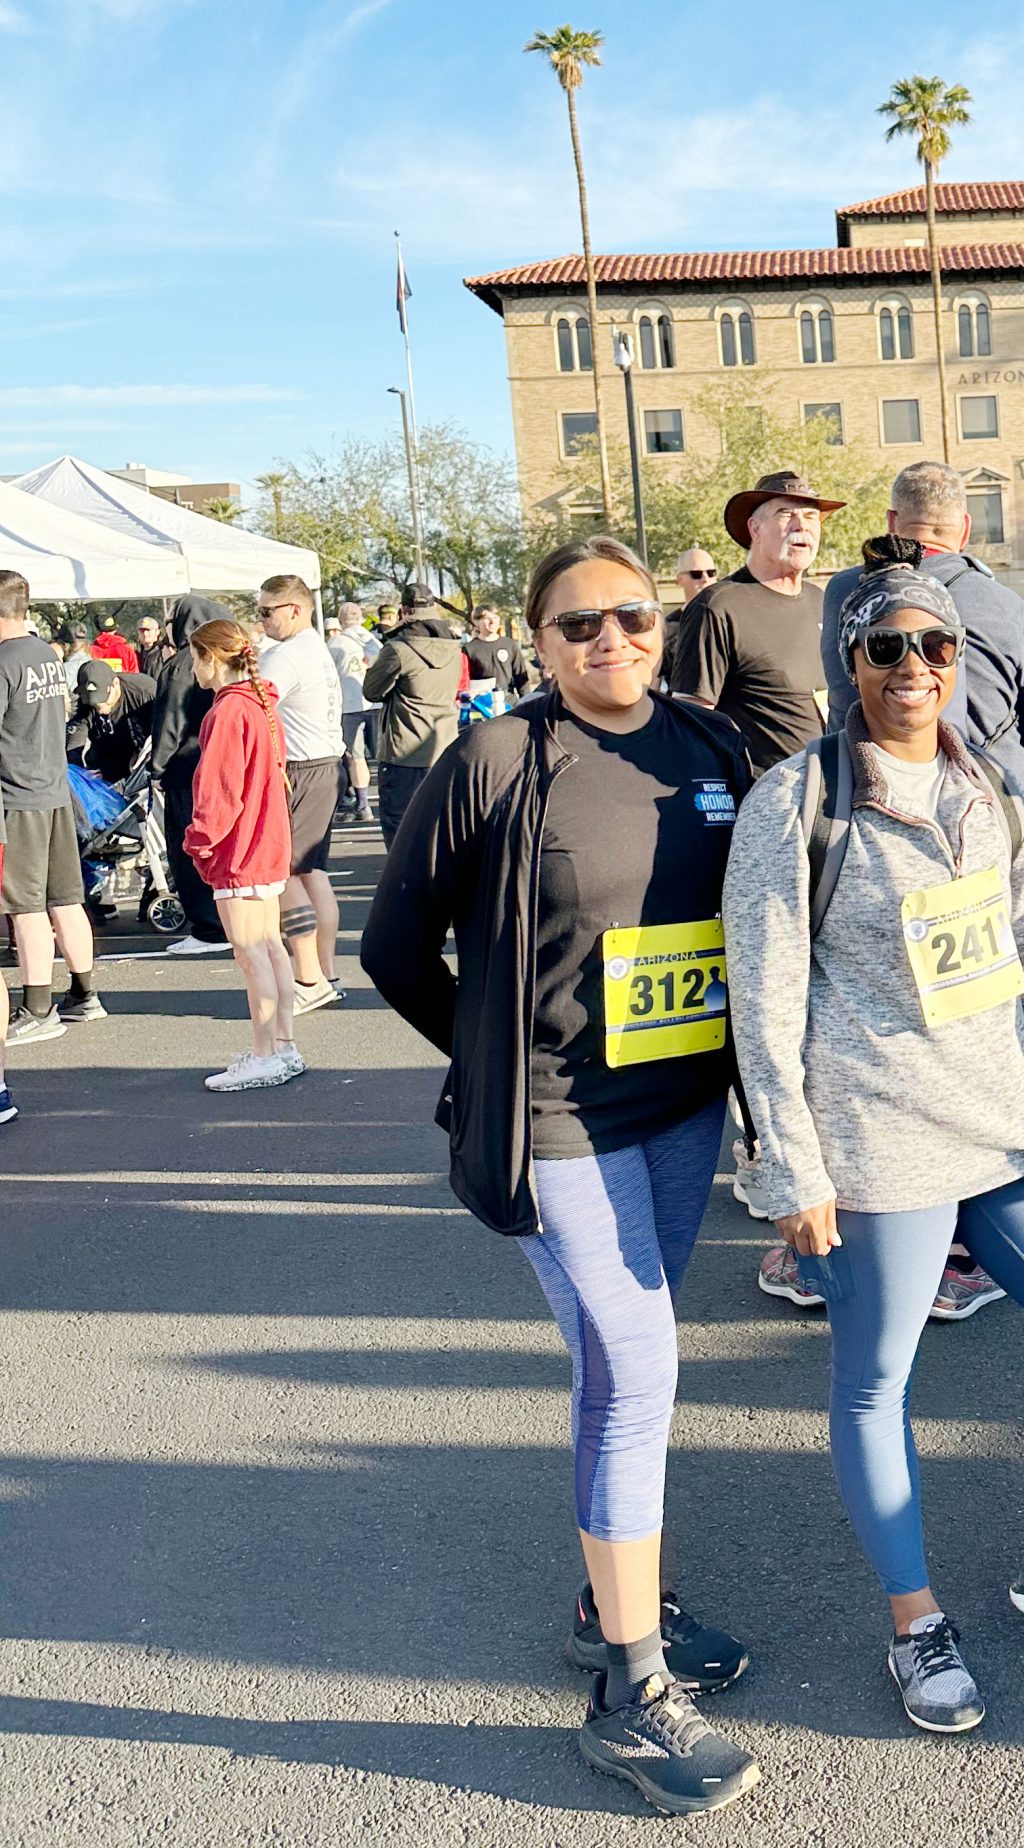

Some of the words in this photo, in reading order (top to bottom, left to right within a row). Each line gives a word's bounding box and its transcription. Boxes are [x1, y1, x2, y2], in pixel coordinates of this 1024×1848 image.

[26, 660, 66, 690] AJPD
[700, 794, 735, 811] HONOR
[638, 951, 698, 967] ARIZONA
[931, 916, 999, 975] 241
[629, 968, 705, 1016] 312
